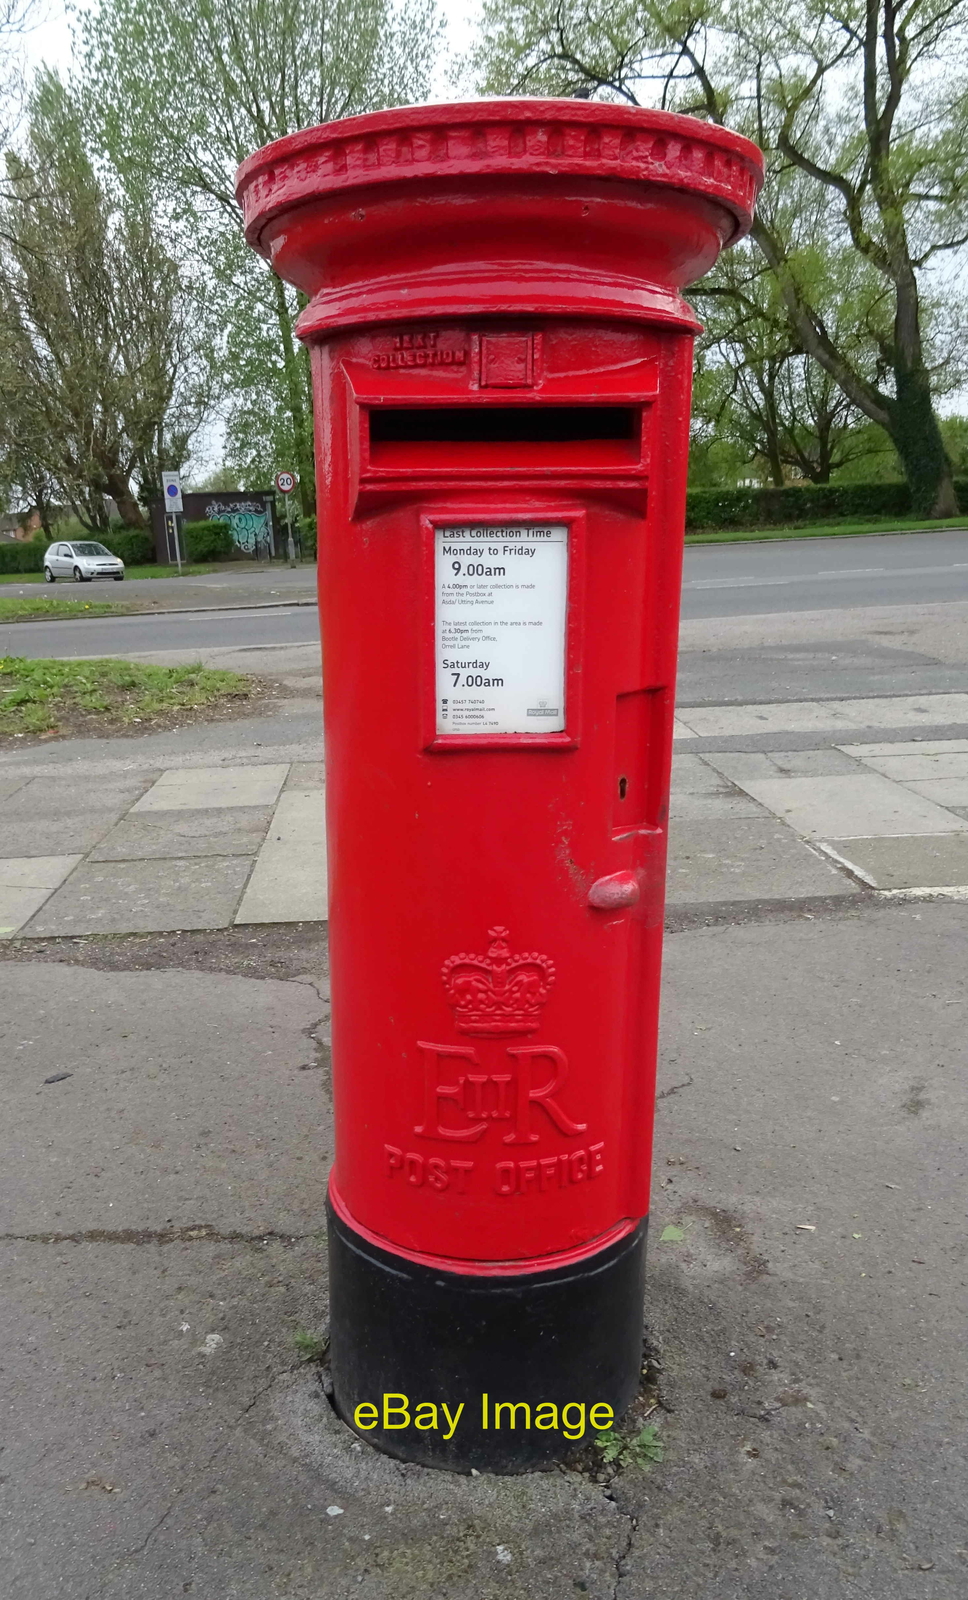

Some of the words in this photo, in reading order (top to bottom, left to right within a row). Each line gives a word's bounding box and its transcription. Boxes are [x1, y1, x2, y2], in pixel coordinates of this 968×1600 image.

[371, 350, 468, 371] COLLECTION
[280, 476, 292, 486] 20
[442, 528, 466, 538] Last
[469, 528, 522, 538] Collection
[525, 528, 552, 538] Time
[442, 546, 484, 558] Monday
[488, 547, 499, 556] to
[502, 546, 536, 558] Friday
[452, 561, 506, 576] 9.00am
[442, 659, 490, 671] Saturday
[450, 672, 504, 688] 7.00am
[384, 1143, 474, 1195] POST
[495, 1141, 605, 1196] OFFICE
